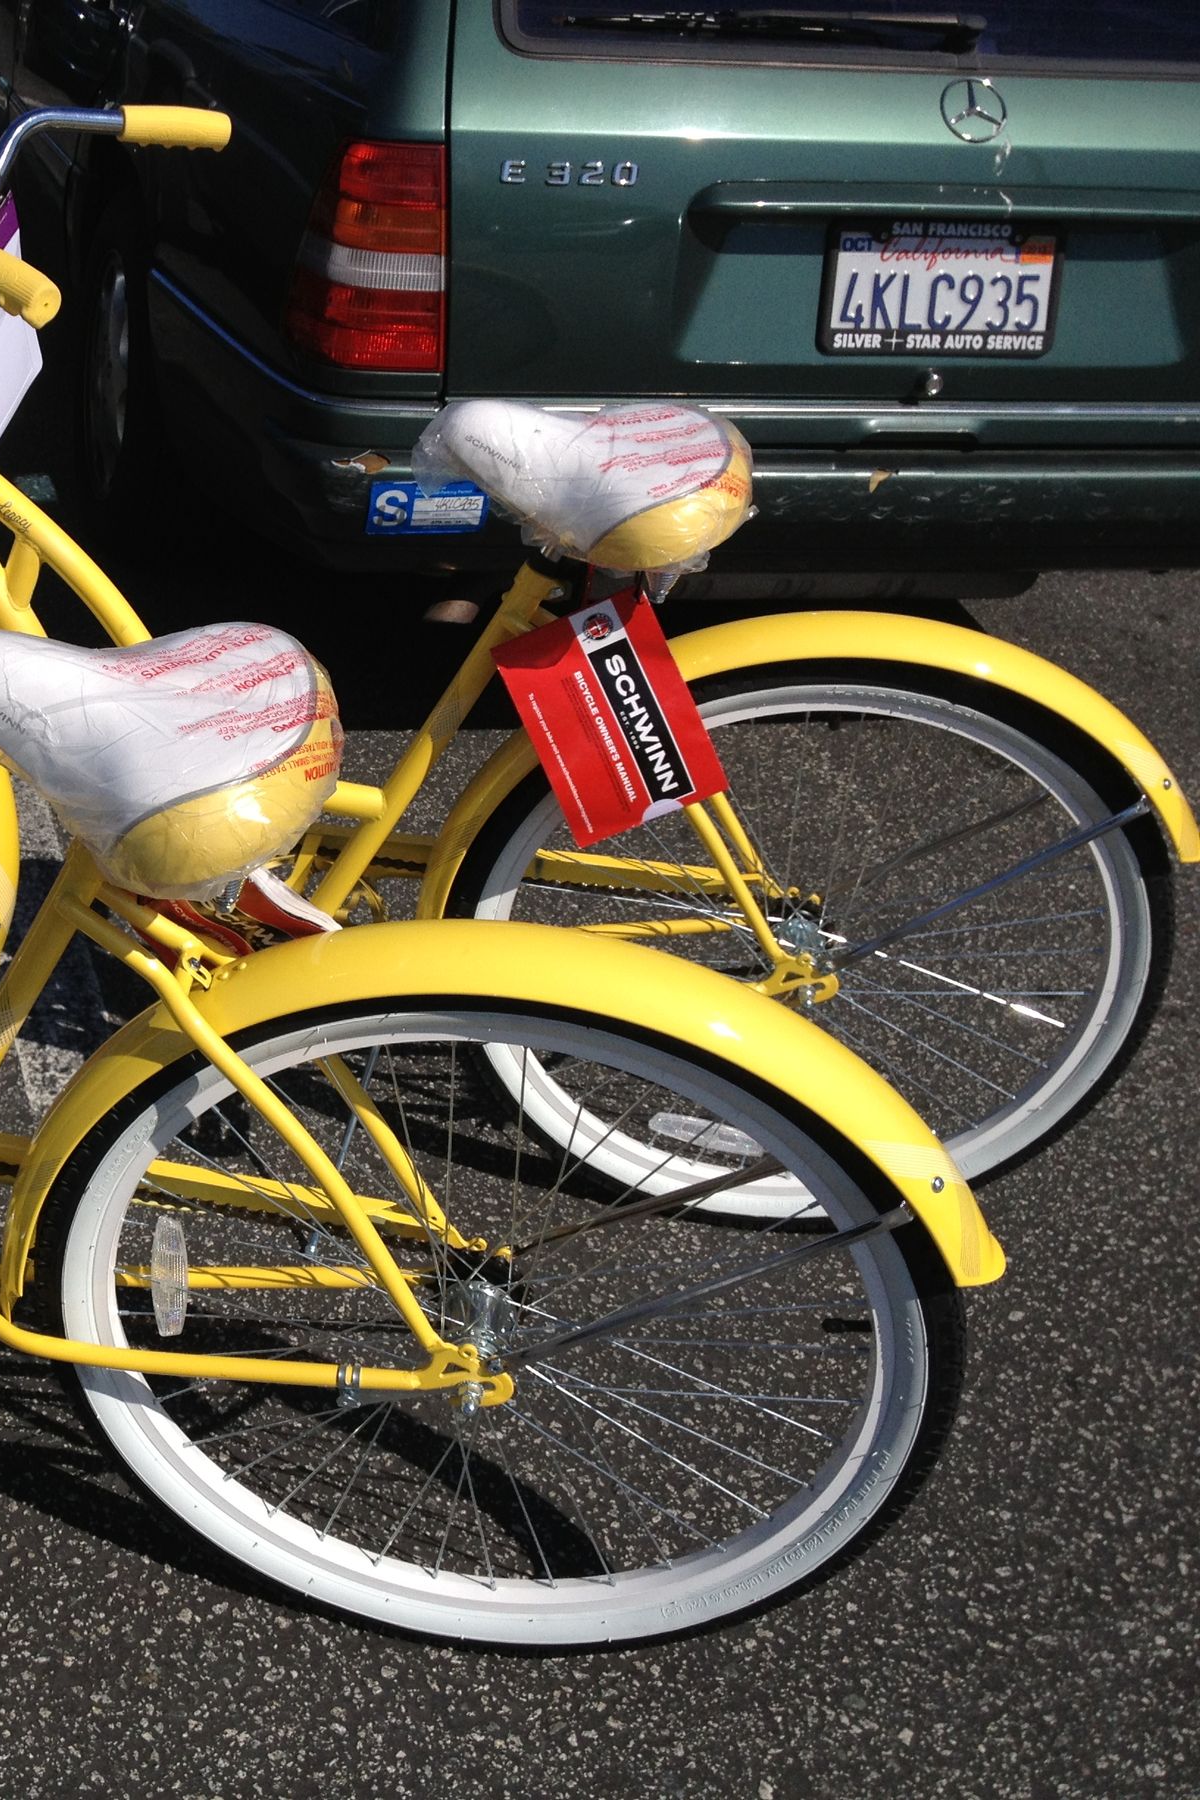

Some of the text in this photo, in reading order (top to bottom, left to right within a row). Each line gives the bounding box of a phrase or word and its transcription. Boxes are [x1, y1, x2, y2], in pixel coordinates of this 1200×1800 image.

[500, 159, 639, 187] E 320
[892, 222, 1012, 238] SAN FRANCISCO
[842, 237, 873, 252] OCT
[880, 237, 1017, 271] California
[840, 271, 1041, 332] 4KLC935
[833, 333, 1044, 351] SILVER STAR AUTO SERVICE
[465, 435, 519, 470] SCHWINN
[373, 489, 409, 527] S
[540, 719, 548, 732] your
[574, 671, 598, 716] BICYCLE
[595, 716, 619, 762] OWNER'S
[616, 759, 637, 803] MANUAL
[605, 654, 678, 794] SCHWINN
[258, 765, 287, 781] PARTS
[304, 761, 337, 782] CAUTION
